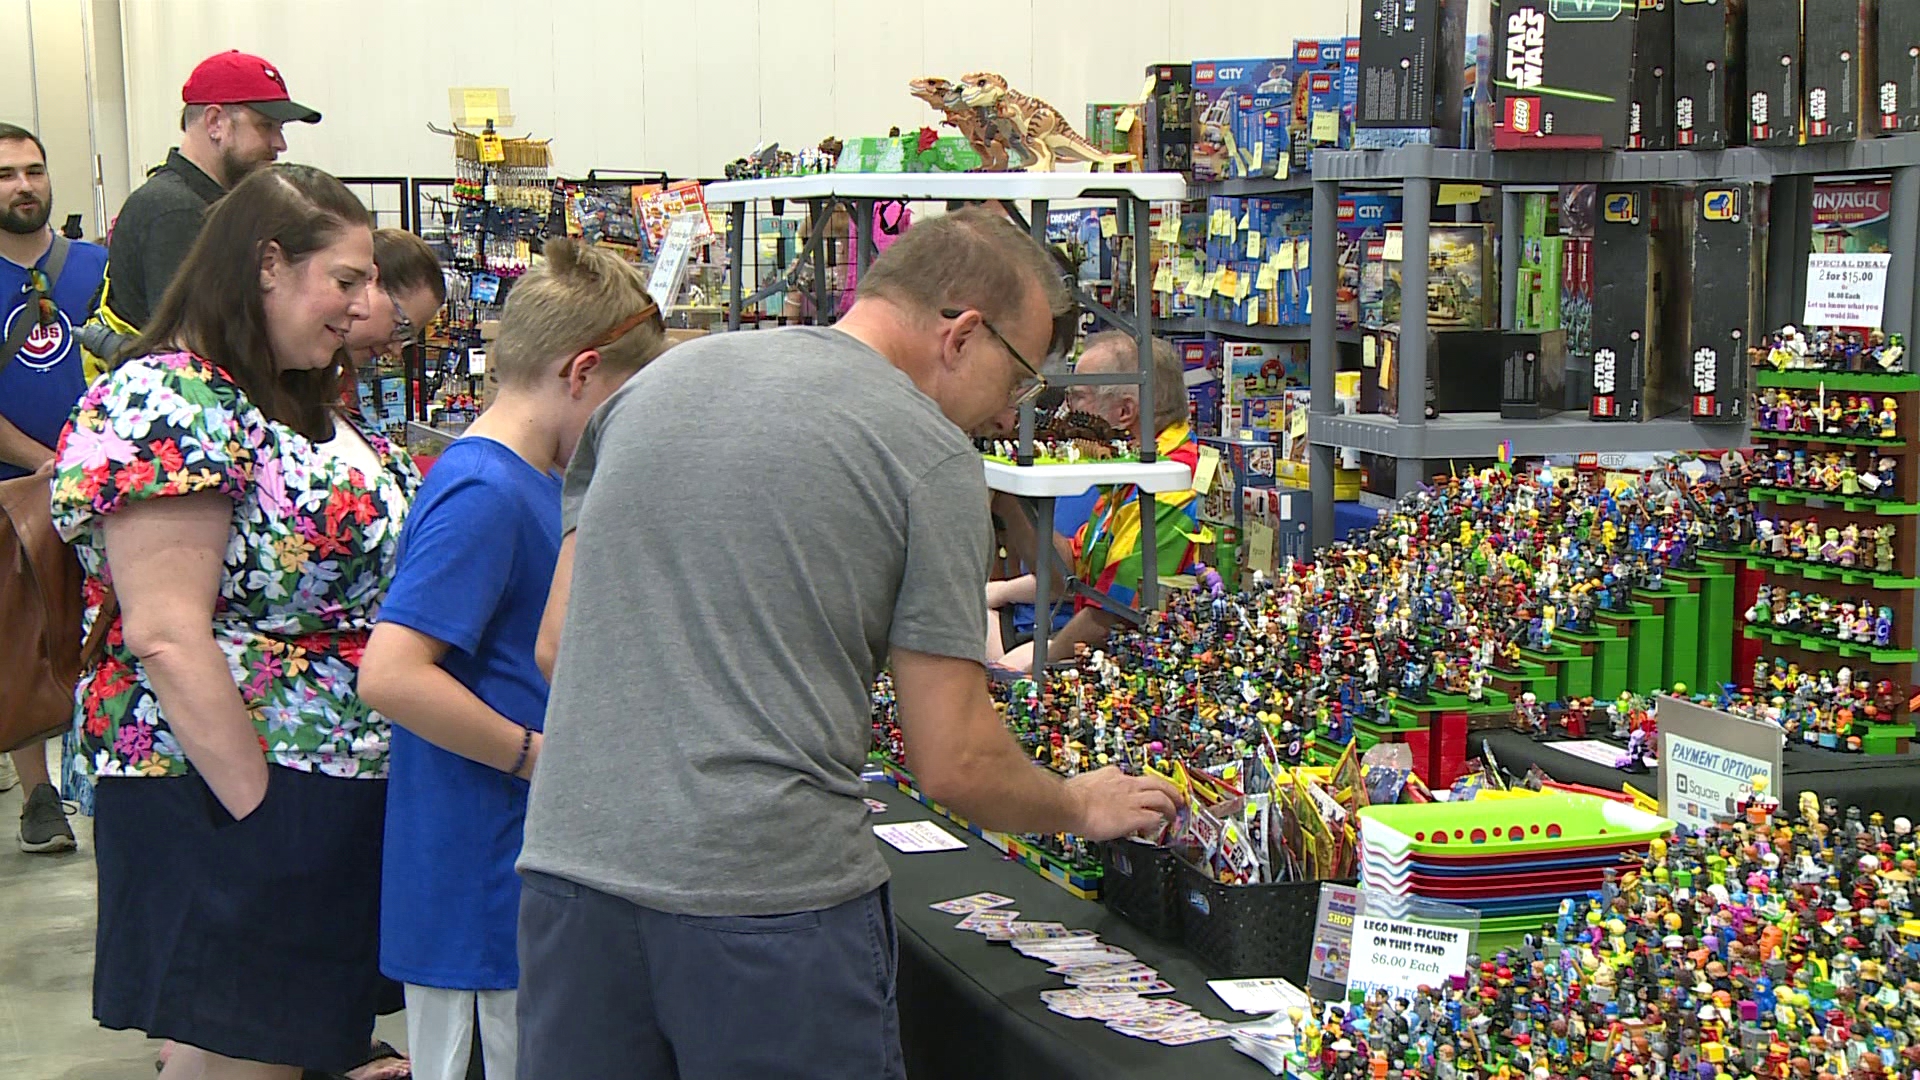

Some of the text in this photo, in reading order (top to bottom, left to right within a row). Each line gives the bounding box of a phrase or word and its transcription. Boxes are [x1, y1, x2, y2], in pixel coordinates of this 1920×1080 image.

[1299, 47, 1341, 59] LEGO CIT
[1346, 48, 1359, 58] LEG
[1506, 8, 1527, 90] STAR
[1523, 8, 1545, 89] WARS
[1196, 67, 1243, 79] LEGO CITY
[1312, 81, 1330, 91] LEGO
[1254, 98, 1271, 106] CITY
[1752, 92, 1762, 124] STAR
[1758, 92, 1768, 124] WARS
[1810, 88, 1820, 120] STAR
[1816, 88, 1826, 120] WARS
[1880, 82, 1890, 114] STAR
[1887, 82, 1897, 114] WARS
[1514, 100, 1530, 131] LEGO
[1677, 98, 1688, 130] STAR
[1683, 98, 1693, 129] WARS
[1358, 205, 1384, 218] CITY
[1819, 269, 1873, 284] 2 for $15.00
[1847, 312, 1860, 320] like
[1185, 350, 1204, 360] LEGO
[1594, 348, 1605, 394] STAR
[1603, 348, 1615, 393] WARS
[1694, 348, 1705, 393] STAR
[1703, 348, 1716, 393] WARS
[1599, 396, 1608, 415] LEGO
[1699, 397, 1709, 415] LEGO
[1580, 454, 1626, 465] LEGO CITY
[1671, 743, 1720, 769] PAYMENT
[1689, 780, 1720, 801] Square
[1328, 912, 1353, 926] SHOP
[1364, 920, 1388, 932] LEGO
[1390, 923, 1458, 943] MINI-FIGURES
[1373, 936, 1445, 956] ON THIS STAND
[1371, 952, 1440, 973] $6.00 Each
